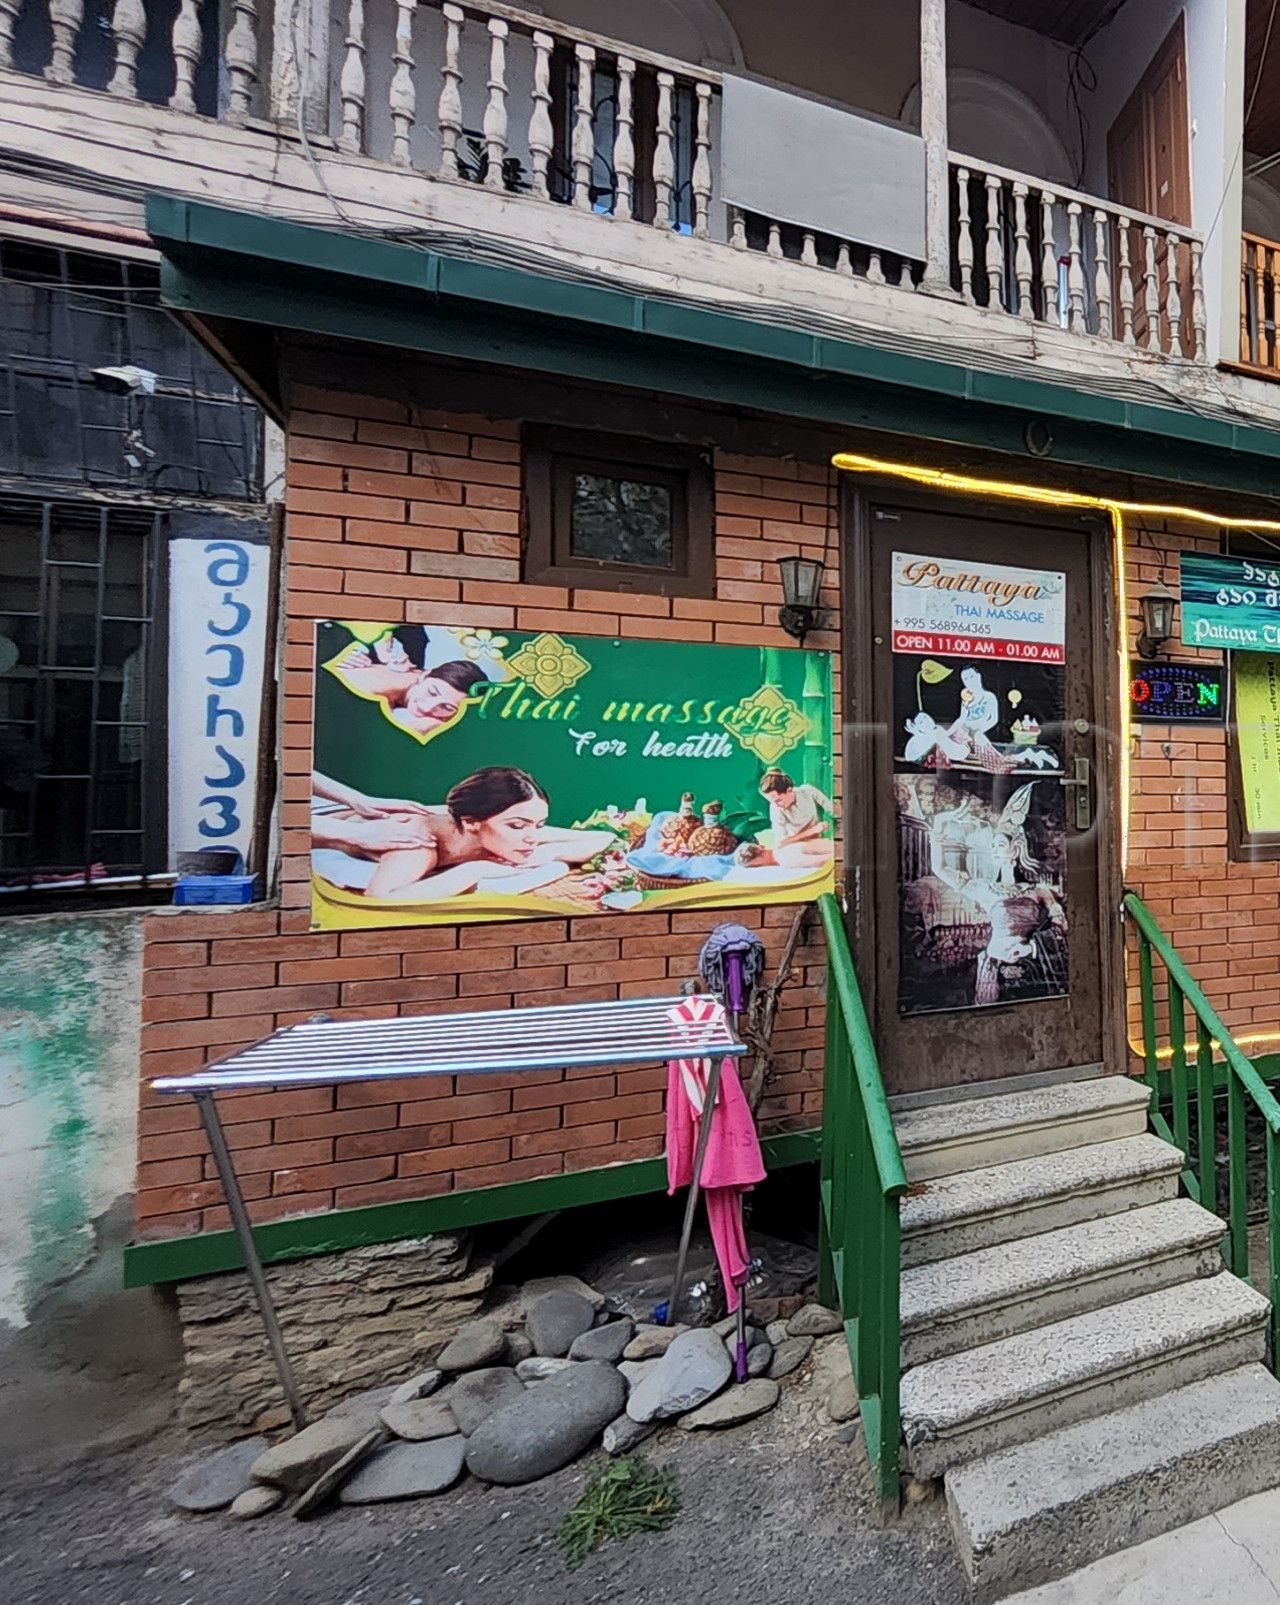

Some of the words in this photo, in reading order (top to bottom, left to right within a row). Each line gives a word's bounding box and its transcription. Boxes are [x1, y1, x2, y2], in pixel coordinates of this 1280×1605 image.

[897, 560, 1045, 607] Pattaya
[1216, 588, 1257, 606] ტაი
[931, 619, 992, 635] 568964365
[955, 604, 982, 617] THAI
[986, 609, 1045, 624] MASSAGE
[1191, 618, 1258, 646] Pattaya
[896, 635, 933, 649] OPEN
[938, 637, 971, 652] 11.00
[974, 641, 995, 654] AM
[1006, 643, 1039, 658] 01.00
[1041, 647, 1060, 660] AM
[1129, 678, 1220, 705] OPEN
[198, 542, 252, 875] მკერავ
[469, 681, 582, 720] Thai
[602, 698, 792, 737] massage
[568, 728, 628, 757] For
[642, 731, 734, 759] health
